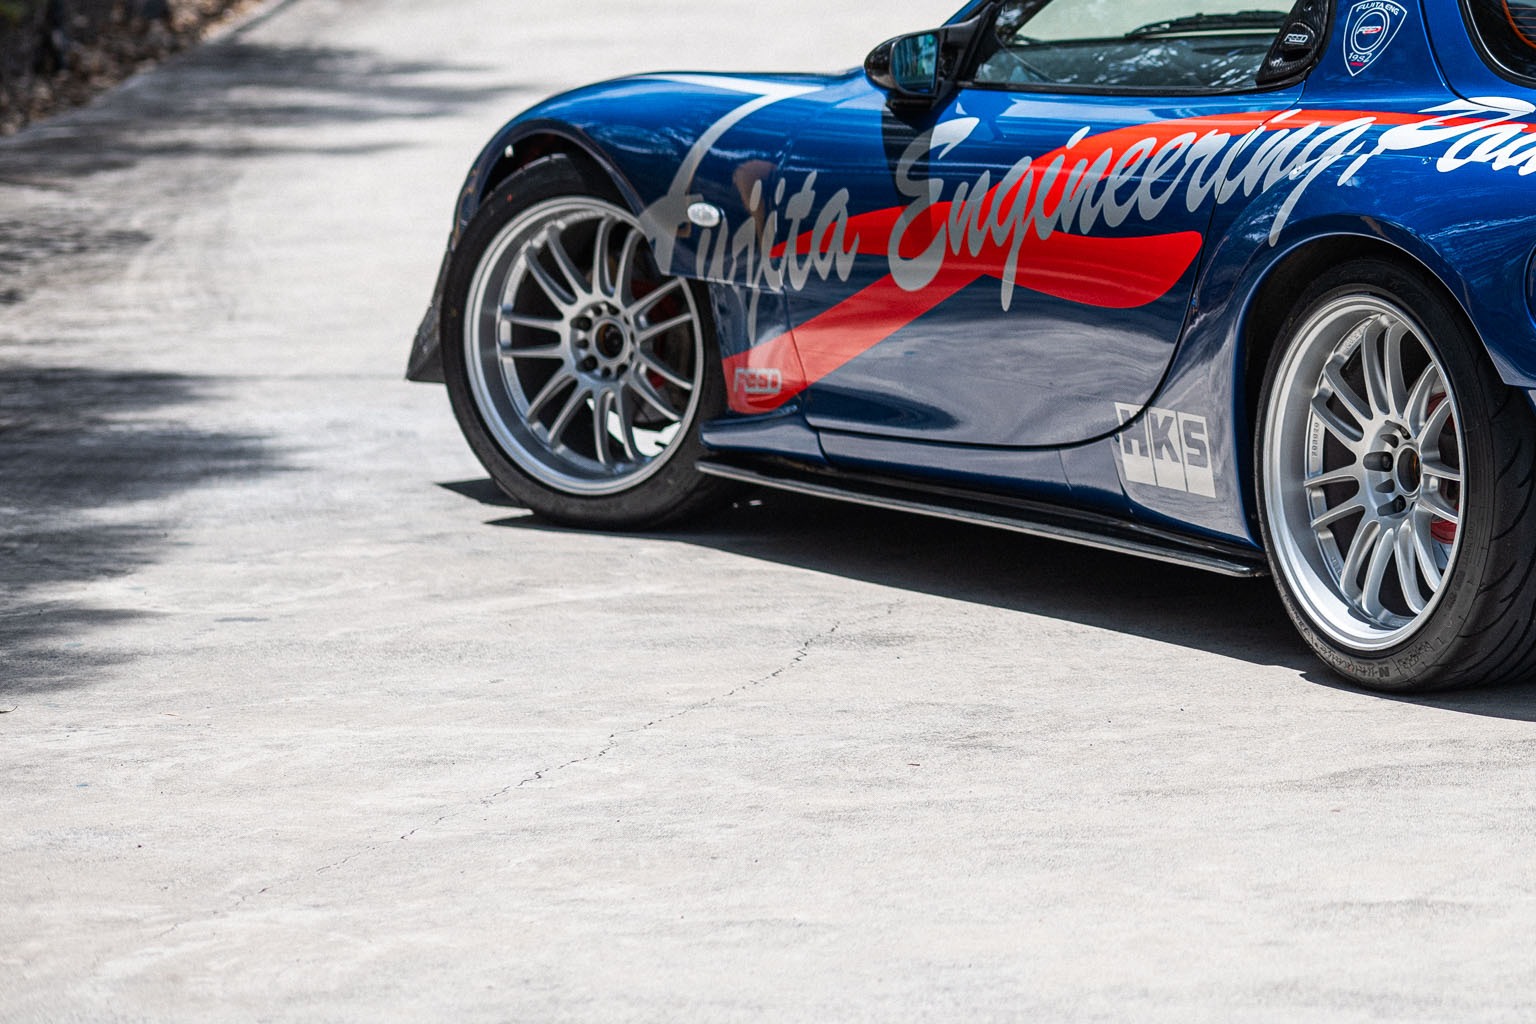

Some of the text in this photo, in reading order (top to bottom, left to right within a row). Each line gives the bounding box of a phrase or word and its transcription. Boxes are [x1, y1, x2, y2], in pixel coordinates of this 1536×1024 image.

[1356, 2, 1400, 16] FUJITA ENG
[887, 108, 1366, 312] Engineering
[1116, 405, 1211, 473] HKS
